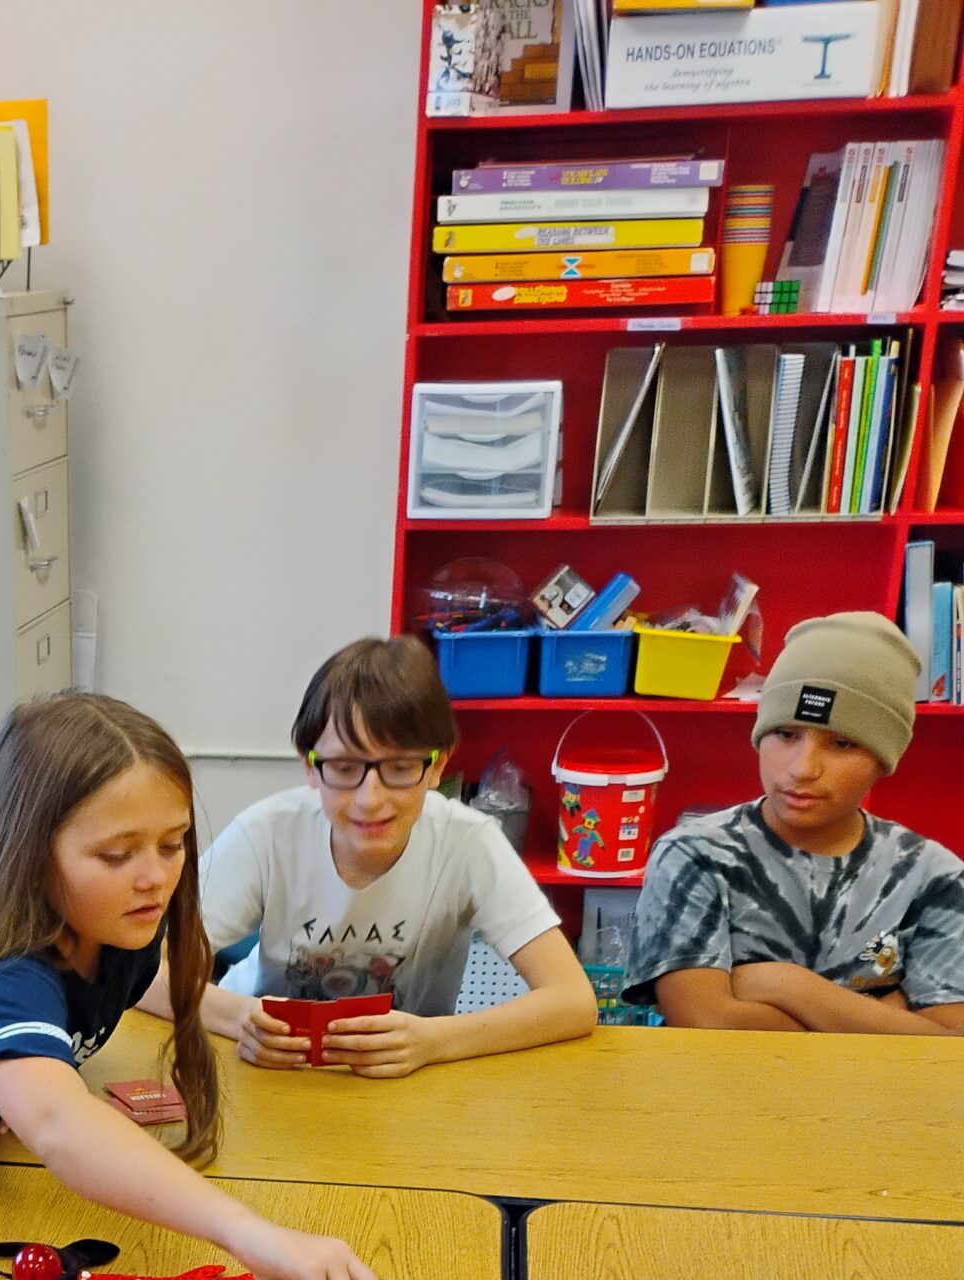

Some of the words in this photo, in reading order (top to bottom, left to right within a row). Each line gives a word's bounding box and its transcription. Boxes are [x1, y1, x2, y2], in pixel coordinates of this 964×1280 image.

[626, 43, 696, 62] HANDS-ON
[699, 39, 777, 59] EQUATIONS
[644, 83, 658, 92] the
[662, 81, 701, 92] learning
[704, 79, 714, 89] of
[715, 78, 751, 89] algebra
